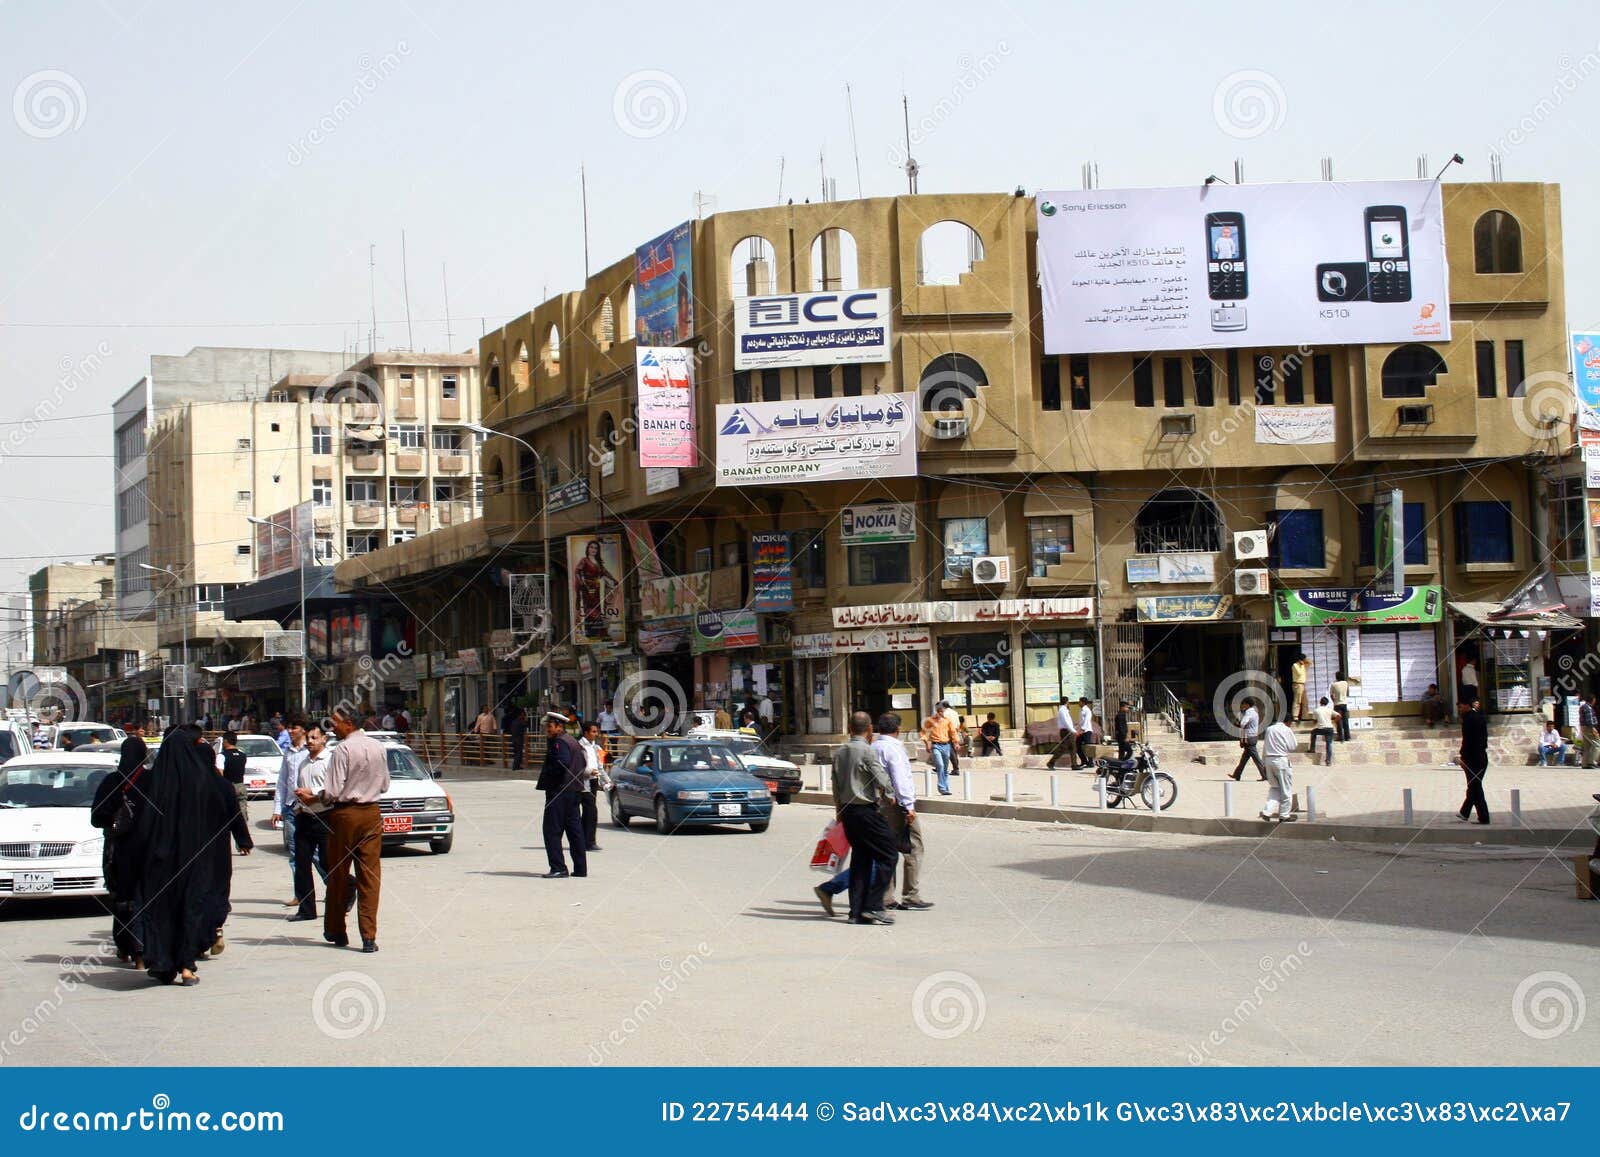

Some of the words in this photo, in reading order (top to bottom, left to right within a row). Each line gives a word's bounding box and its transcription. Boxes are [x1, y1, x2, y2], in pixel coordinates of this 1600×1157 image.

[1062, 204, 1086, 212] Sony
[1088, 202, 1126, 210] Ericsson
[643, 420, 676, 430] BANAH
[680, 420, 694, 431] Co.
[722, 465, 760, 477] BANAH
[765, 463, 821, 475] COMPANY
[856, 513, 897, 529] NOKIA
[752, 534, 790, 543] NOKIA
[1308, 590, 1348, 599] SAMSUNG
